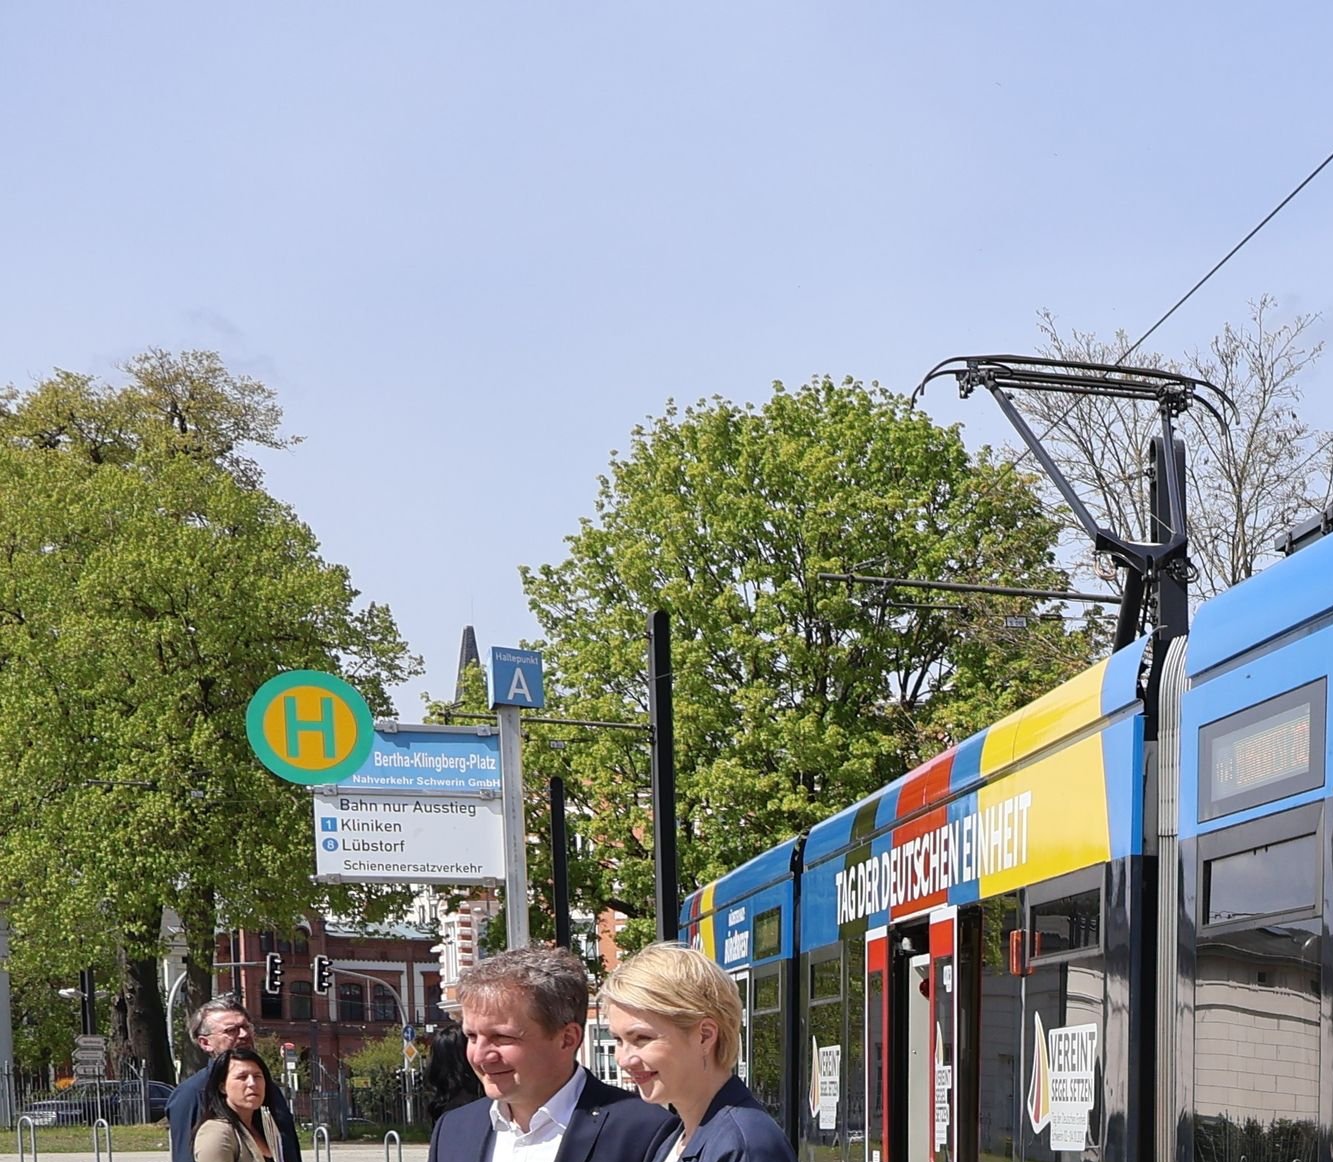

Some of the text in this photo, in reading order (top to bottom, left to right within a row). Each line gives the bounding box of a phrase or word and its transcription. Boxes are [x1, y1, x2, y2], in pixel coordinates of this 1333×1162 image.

[494, 651, 539, 666] Haltepunkt
[507, 667, 533, 703] A
[283, 695, 337, 761] H
[374, 750, 497, 772] Bertha-Klingberg-Platz
[352, 774, 501, 788] Nahverkehr Schwerin GmbH
[340, 798, 477, 817] Bahn nur Ausstieg
[341, 818, 402, 833] Kliniken
[342, 838, 405, 852] Lübstorf
[343, 859, 483, 874] Schienenersatzverkehr
[835, 790, 1032, 926] TAG DER DEUTSCHEN EINHEIT
[1050, 1031, 1096, 1072] VEREINT
[1051, 1078, 1093, 1103] SEGEL SETZEN
